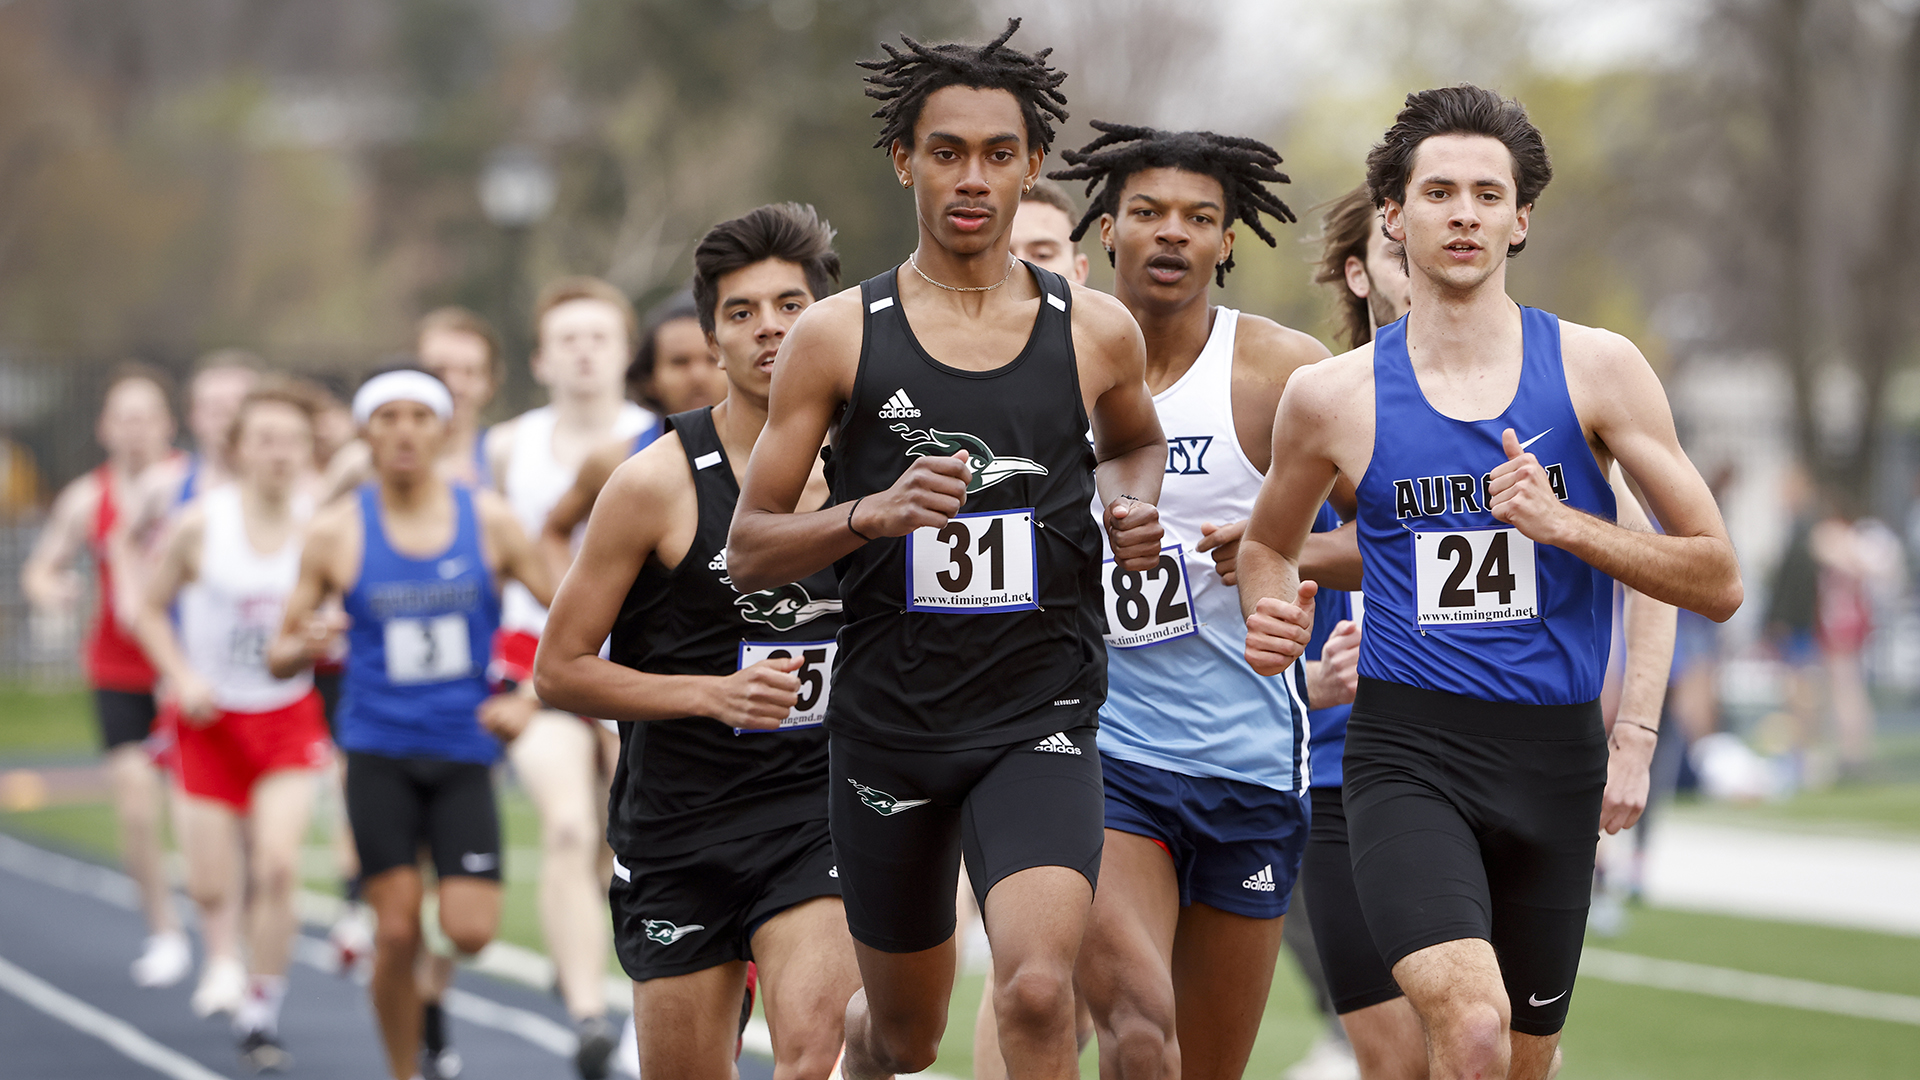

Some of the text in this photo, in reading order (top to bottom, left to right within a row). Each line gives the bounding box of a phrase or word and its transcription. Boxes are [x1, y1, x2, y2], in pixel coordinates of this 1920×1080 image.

[878, 407, 922, 419] adidas
[1393, 463, 1568, 520] AURA
[935, 518, 1004, 593] 31
[1437, 531, 1516, 608] 24
[917, 592, 1031, 607] www.timingmd.net
[1102, 554, 1190, 634] 82
[1421, 606, 1534, 623] www.timingmd.net
[766, 648, 827, 712] 5
[1034, 744, 1082, 756] adidas
[1242, 879, 1276, 892] adidas
